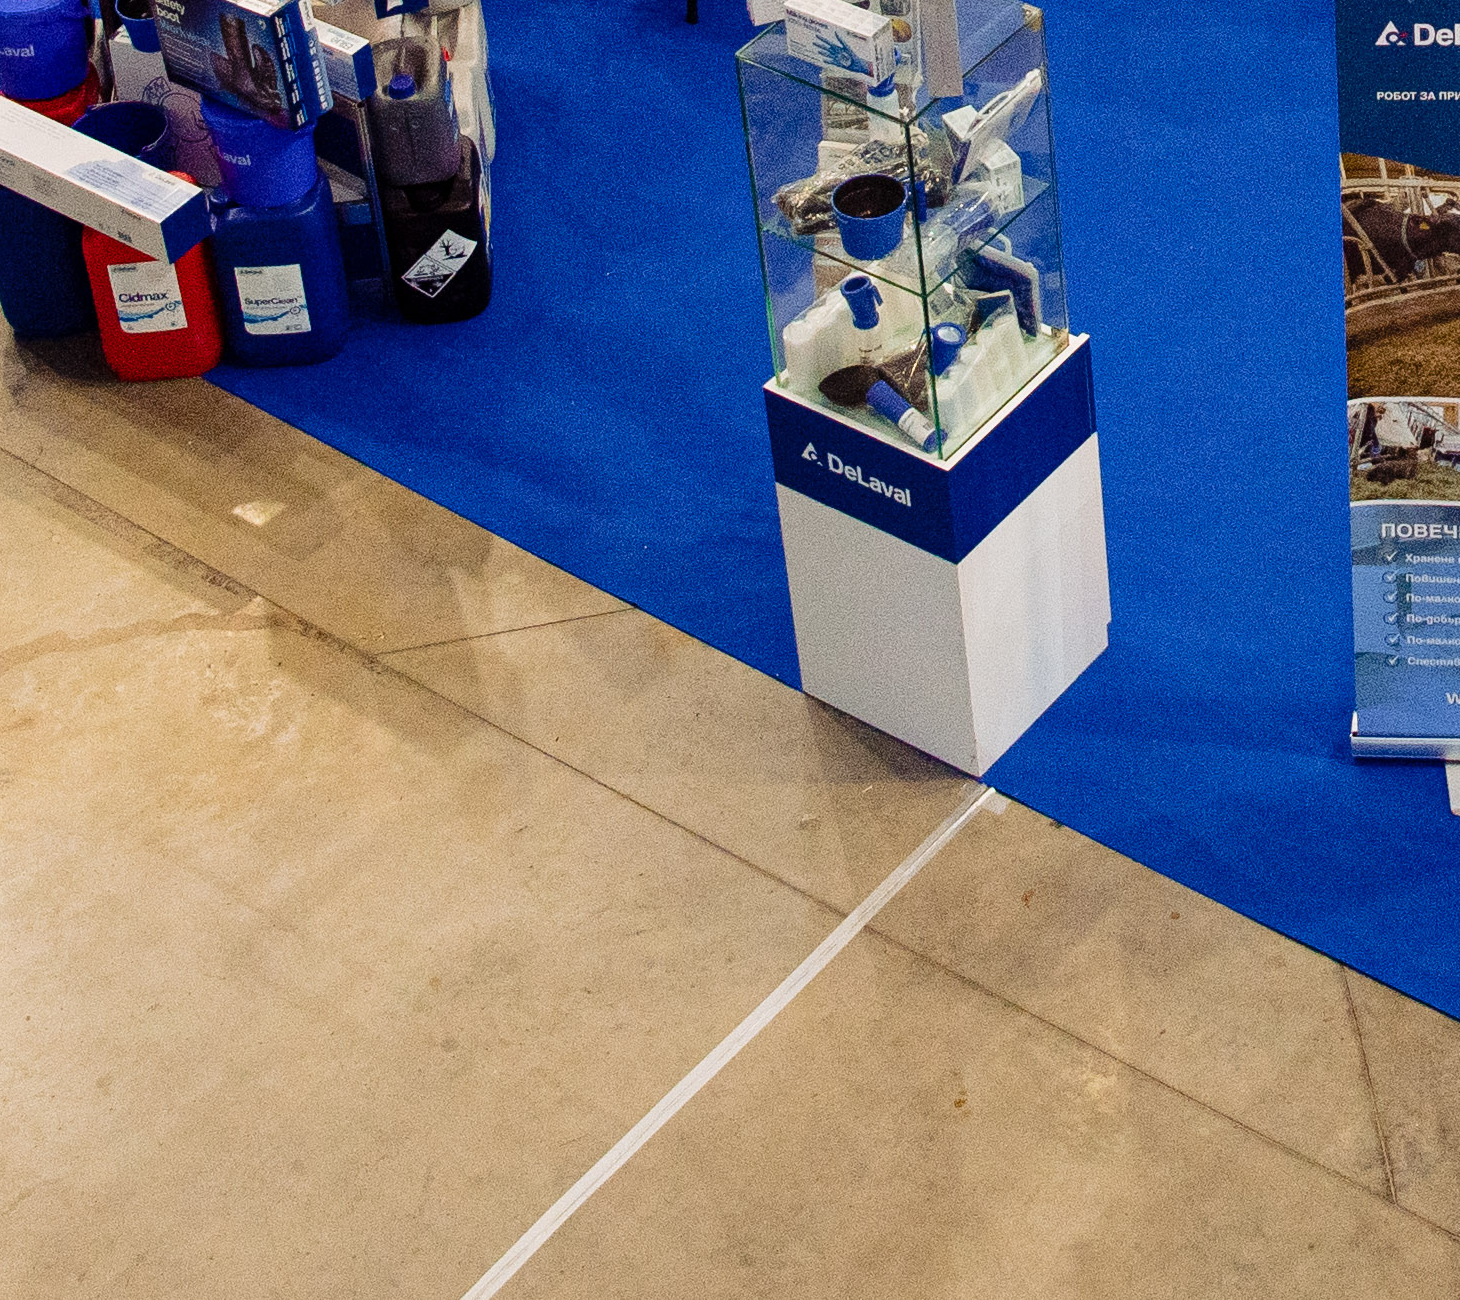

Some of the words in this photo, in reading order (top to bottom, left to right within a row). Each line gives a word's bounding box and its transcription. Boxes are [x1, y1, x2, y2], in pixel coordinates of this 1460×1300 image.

[155, 5, 181, 24] boot
[1376, 91, 1418, 101] РОБОТ
[1419, 91, 1437, 101] ЗА
[826, 451, 912, 508] DeLaval
